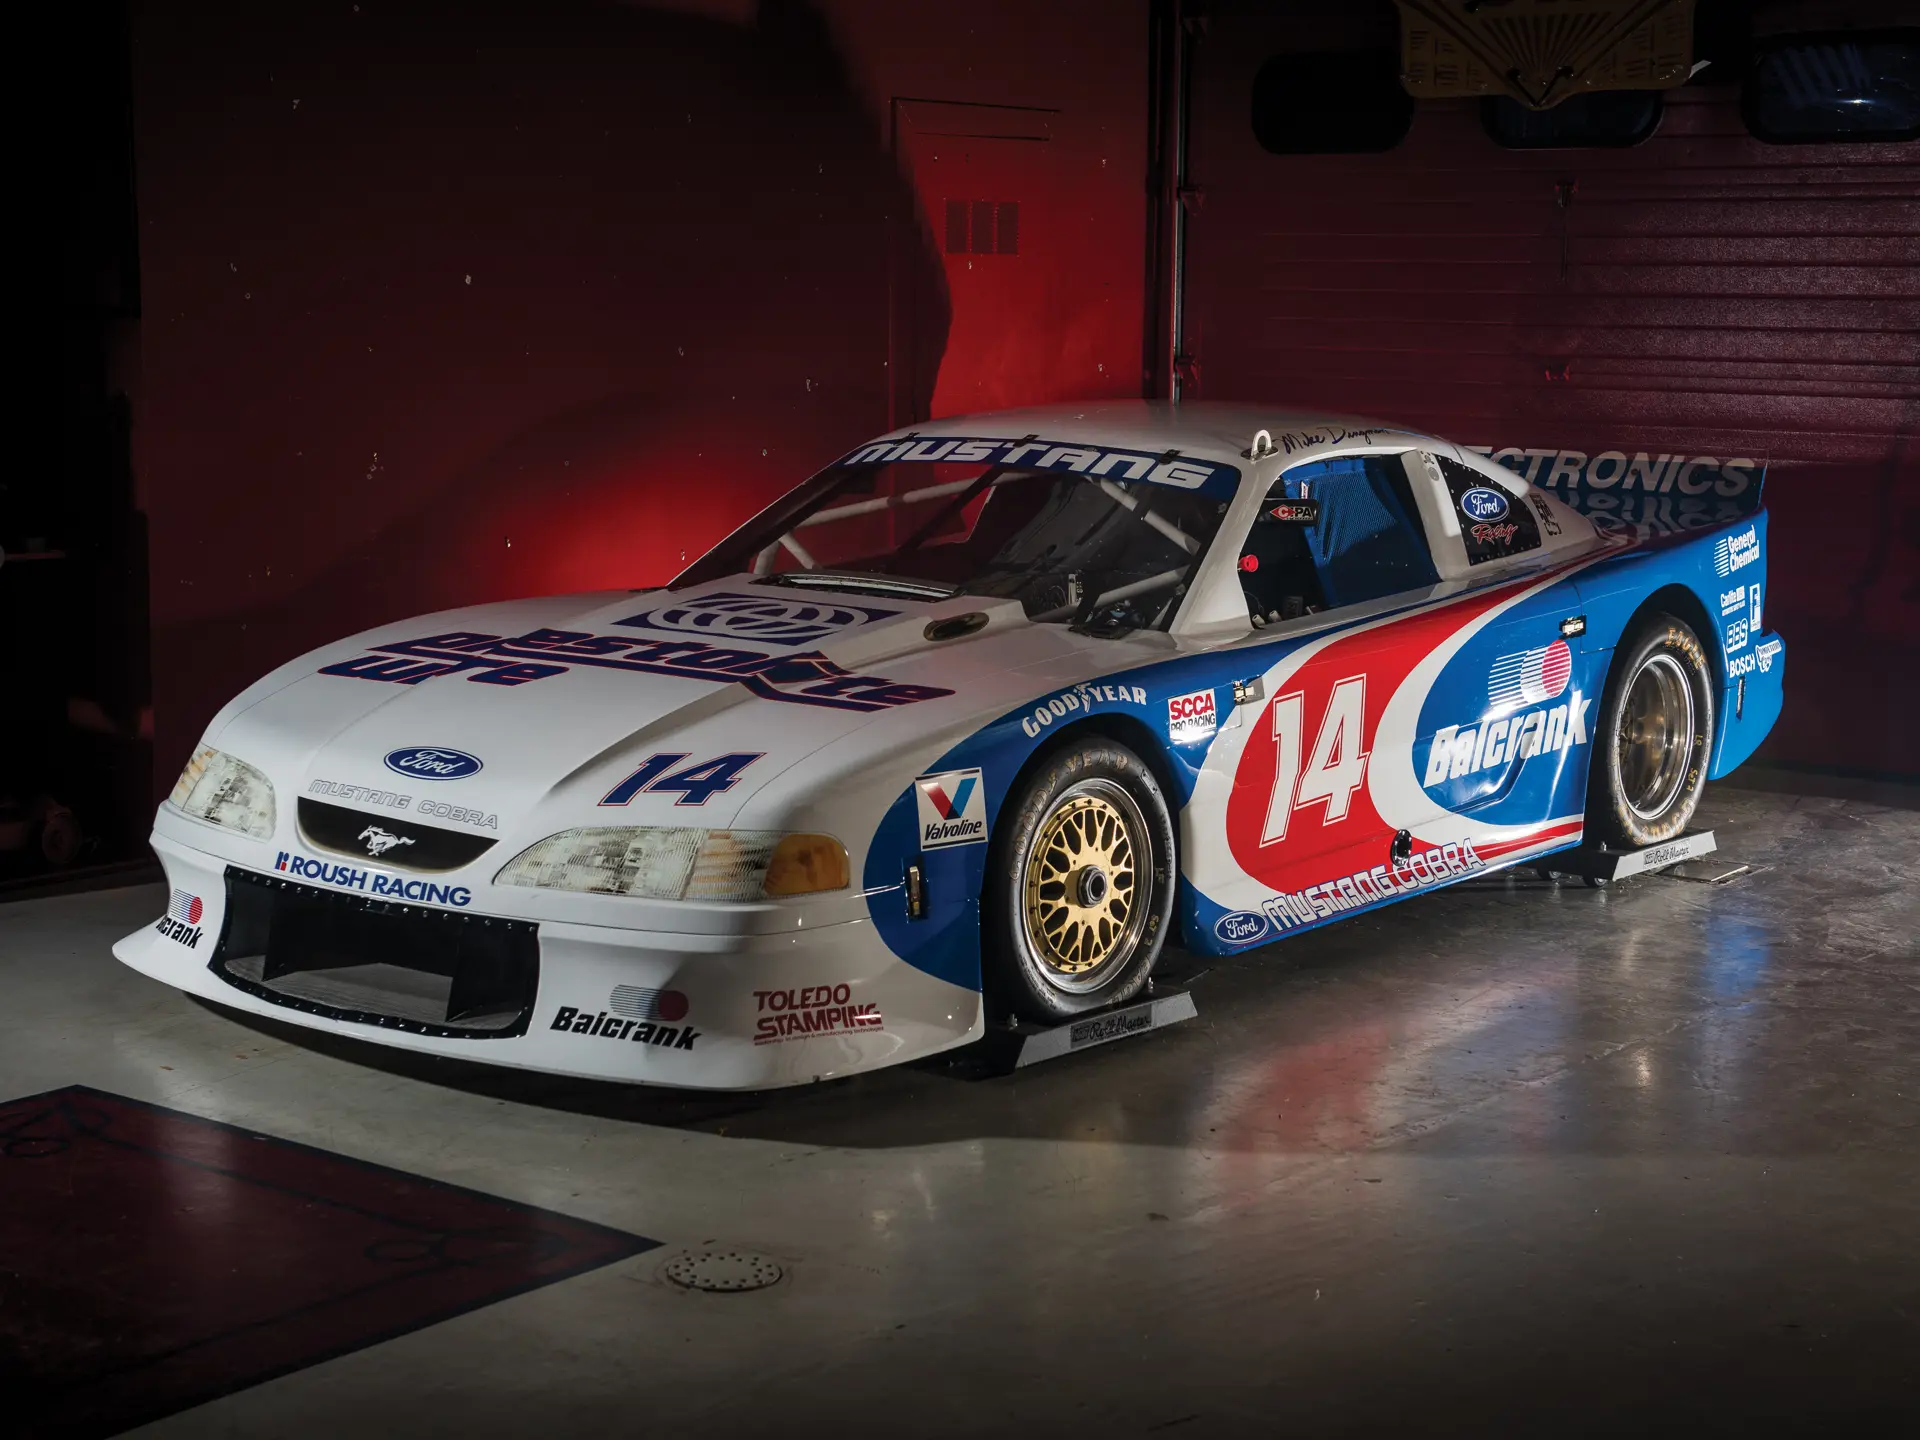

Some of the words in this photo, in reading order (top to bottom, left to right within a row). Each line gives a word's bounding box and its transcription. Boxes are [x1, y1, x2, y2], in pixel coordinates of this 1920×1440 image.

[845, 441, 1214, 490] MUSTANG
[1464, 446, 1754, 498] CTRONICS
[1471, 523, 1518, 545] Racing
[1728, 525, 1756, 553] General
[1730, 540, 1760, 572] Chemical
[1726, 618, 1748, 654] BBS
[1729, 653, 1756, 678] BOSCH
[1170, 693, 1214, 720] SCCA
[1423, 690, 1592, 788] Balcrank
[396, 749, 464, 775] Ford
[597, 752, 767, 806] 14
[1259, 673, 1370, 848] 14
[308, 779, 412, 809] MUSTANG
[417, 800, 498, 829] COBRA
[925, 819, 982, 841] Valvoline
[290, 856, 368, 890] ROUSH
[371, 874, 471, 906] RACING
[1225, 916, 1258, 939] Ford
[1262, 864, 1399, 931] MUSTANG
[1392, 838, 1486, 890] COBRA
[753, 983, 851, 1012] TOLEDO
[550, 1006, 702, 1050] Balcrank
[754, 1003, 882, 1041] STAMPING
